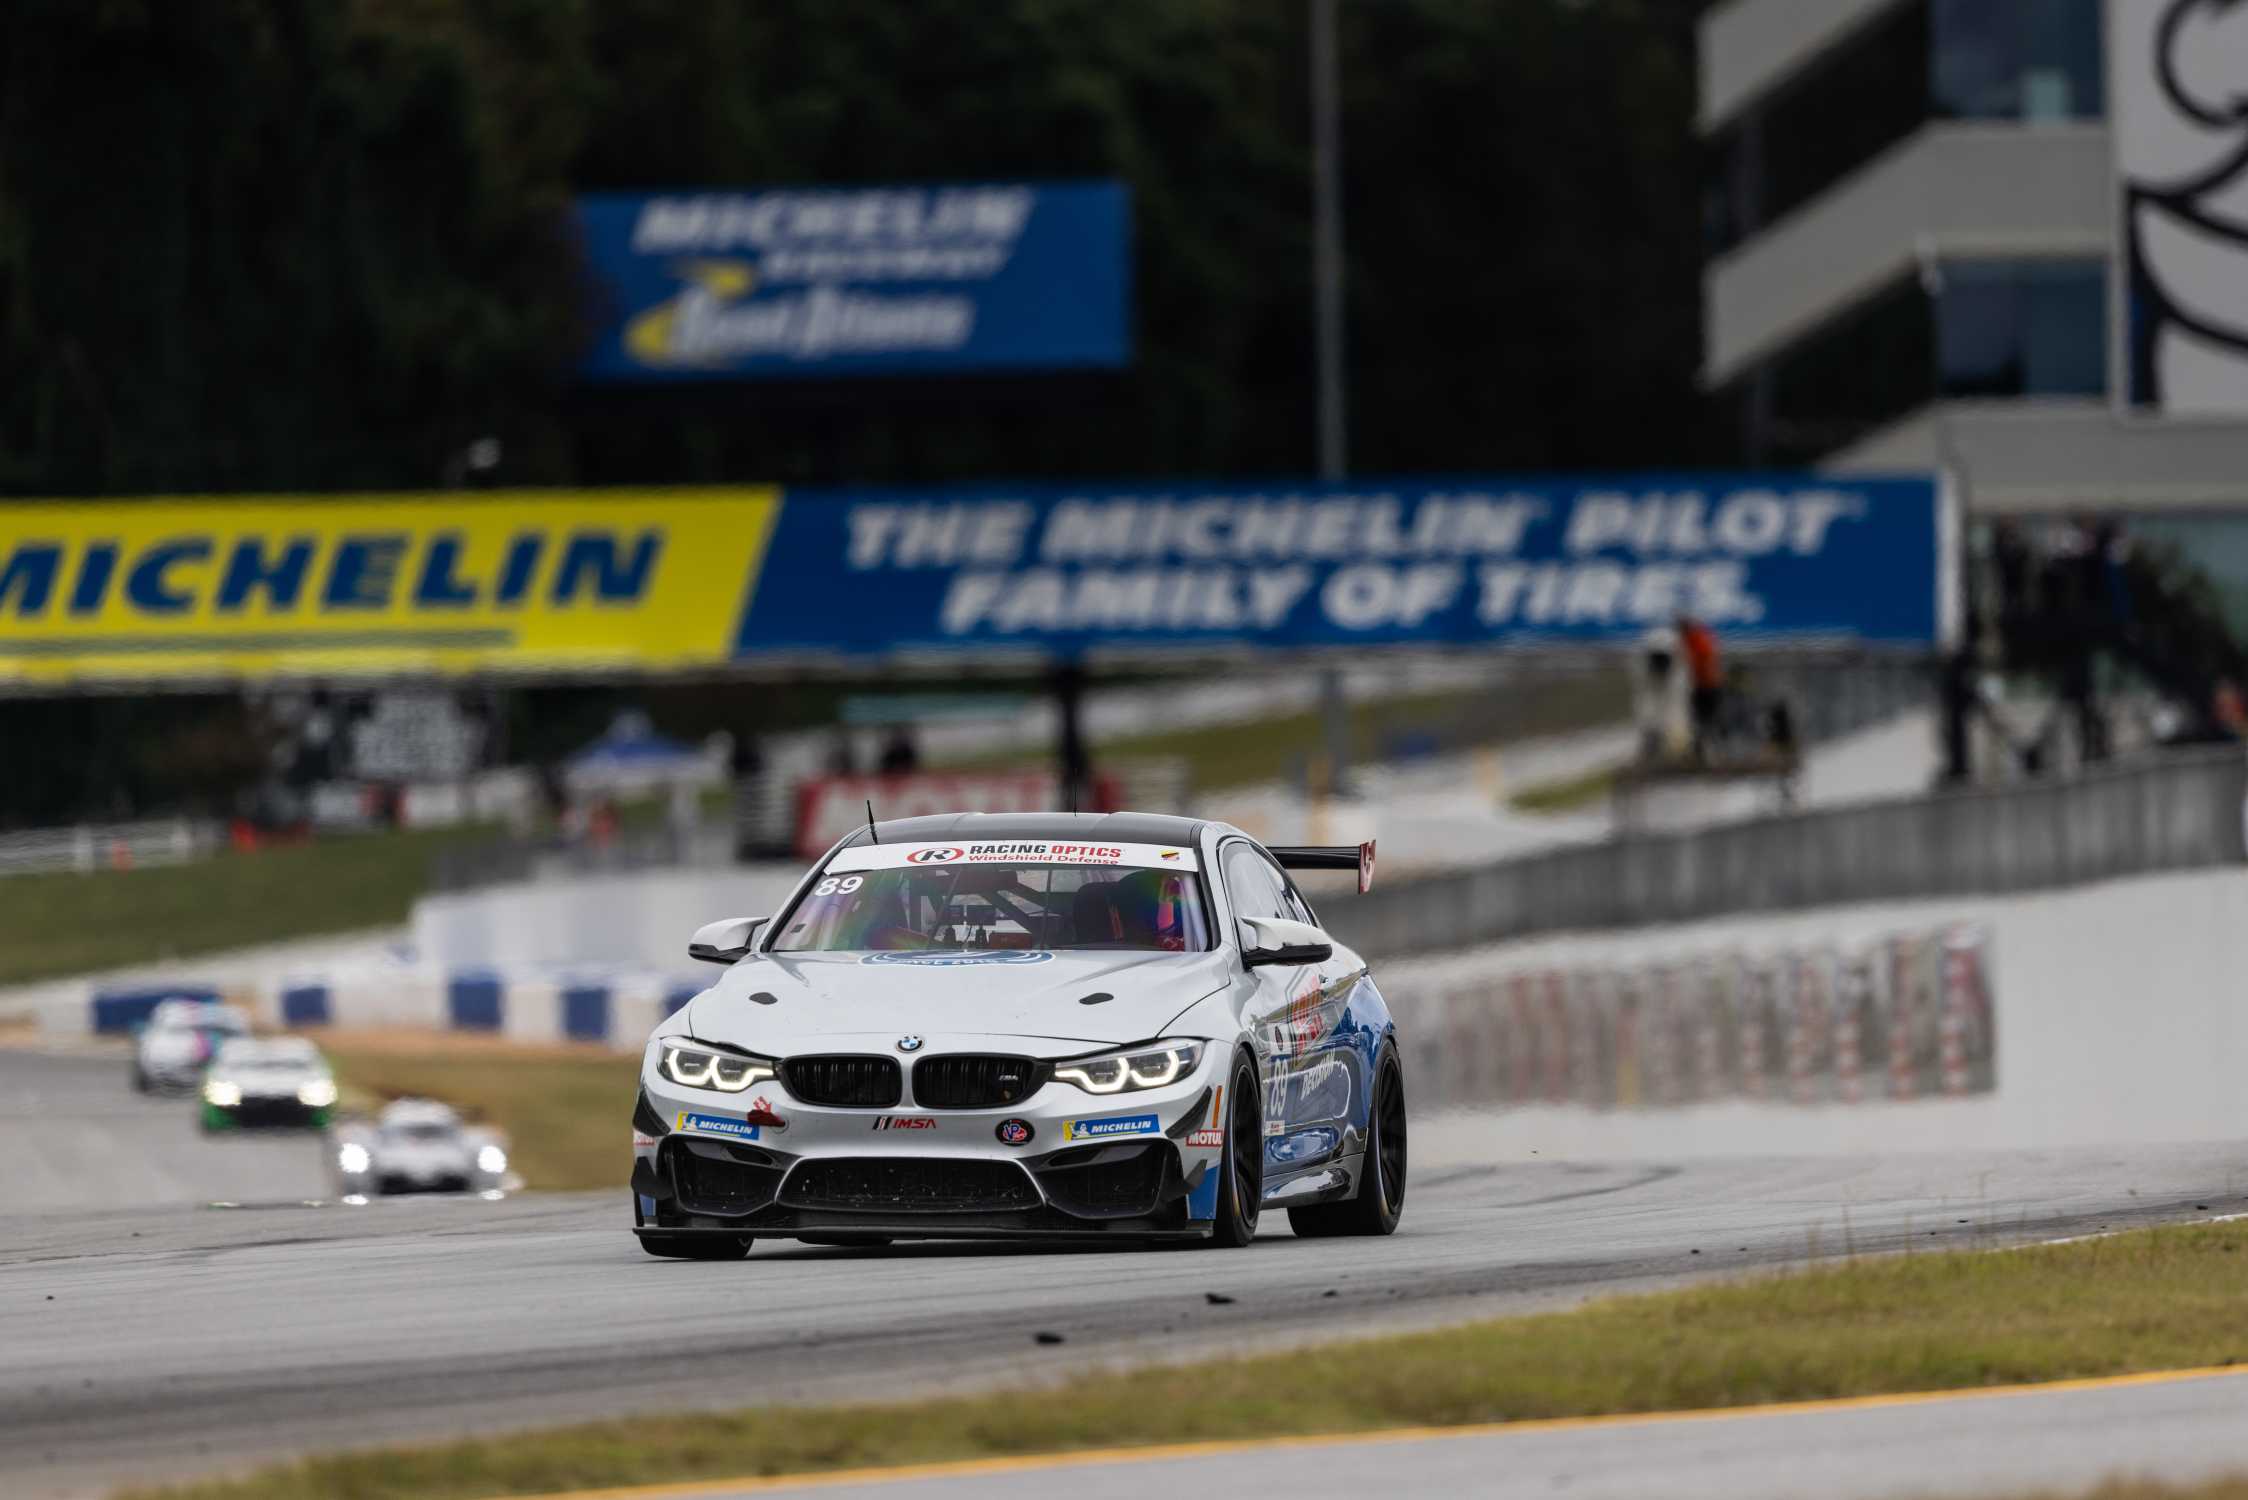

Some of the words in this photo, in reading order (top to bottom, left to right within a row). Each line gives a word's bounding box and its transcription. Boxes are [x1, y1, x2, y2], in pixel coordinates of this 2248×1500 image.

[848, 502, 1034, 568] THE
[1040, 496, 1528, 560] MICHELIN
[1565, 490, 1846, 554] PILOT
[0, 528, 662, 616] MICHELIN
[942, 566, 1312, 635] FAMILY
[1320, 564, 1464, 631] OF
[1475, 561, 1764, 626] TIRES.
[970, 844, 1047, 854] RACING
[1051, 845, 1122, 858] OPTICS
[968, 854, 1053, 862] Windshield
[1057, 855, 1119, 865] Defense
[815, 876, 863, 896] 89
[1270, 1058, 1289, 1117] 89
[699, 1120, 753, 1135] MICHELIN
[893, 1118, 937, 1129] IMSA
[1091, 1120, 1152, 1133] MICHELIN
[1188, 1131, 1223, 1145] MOTUL
